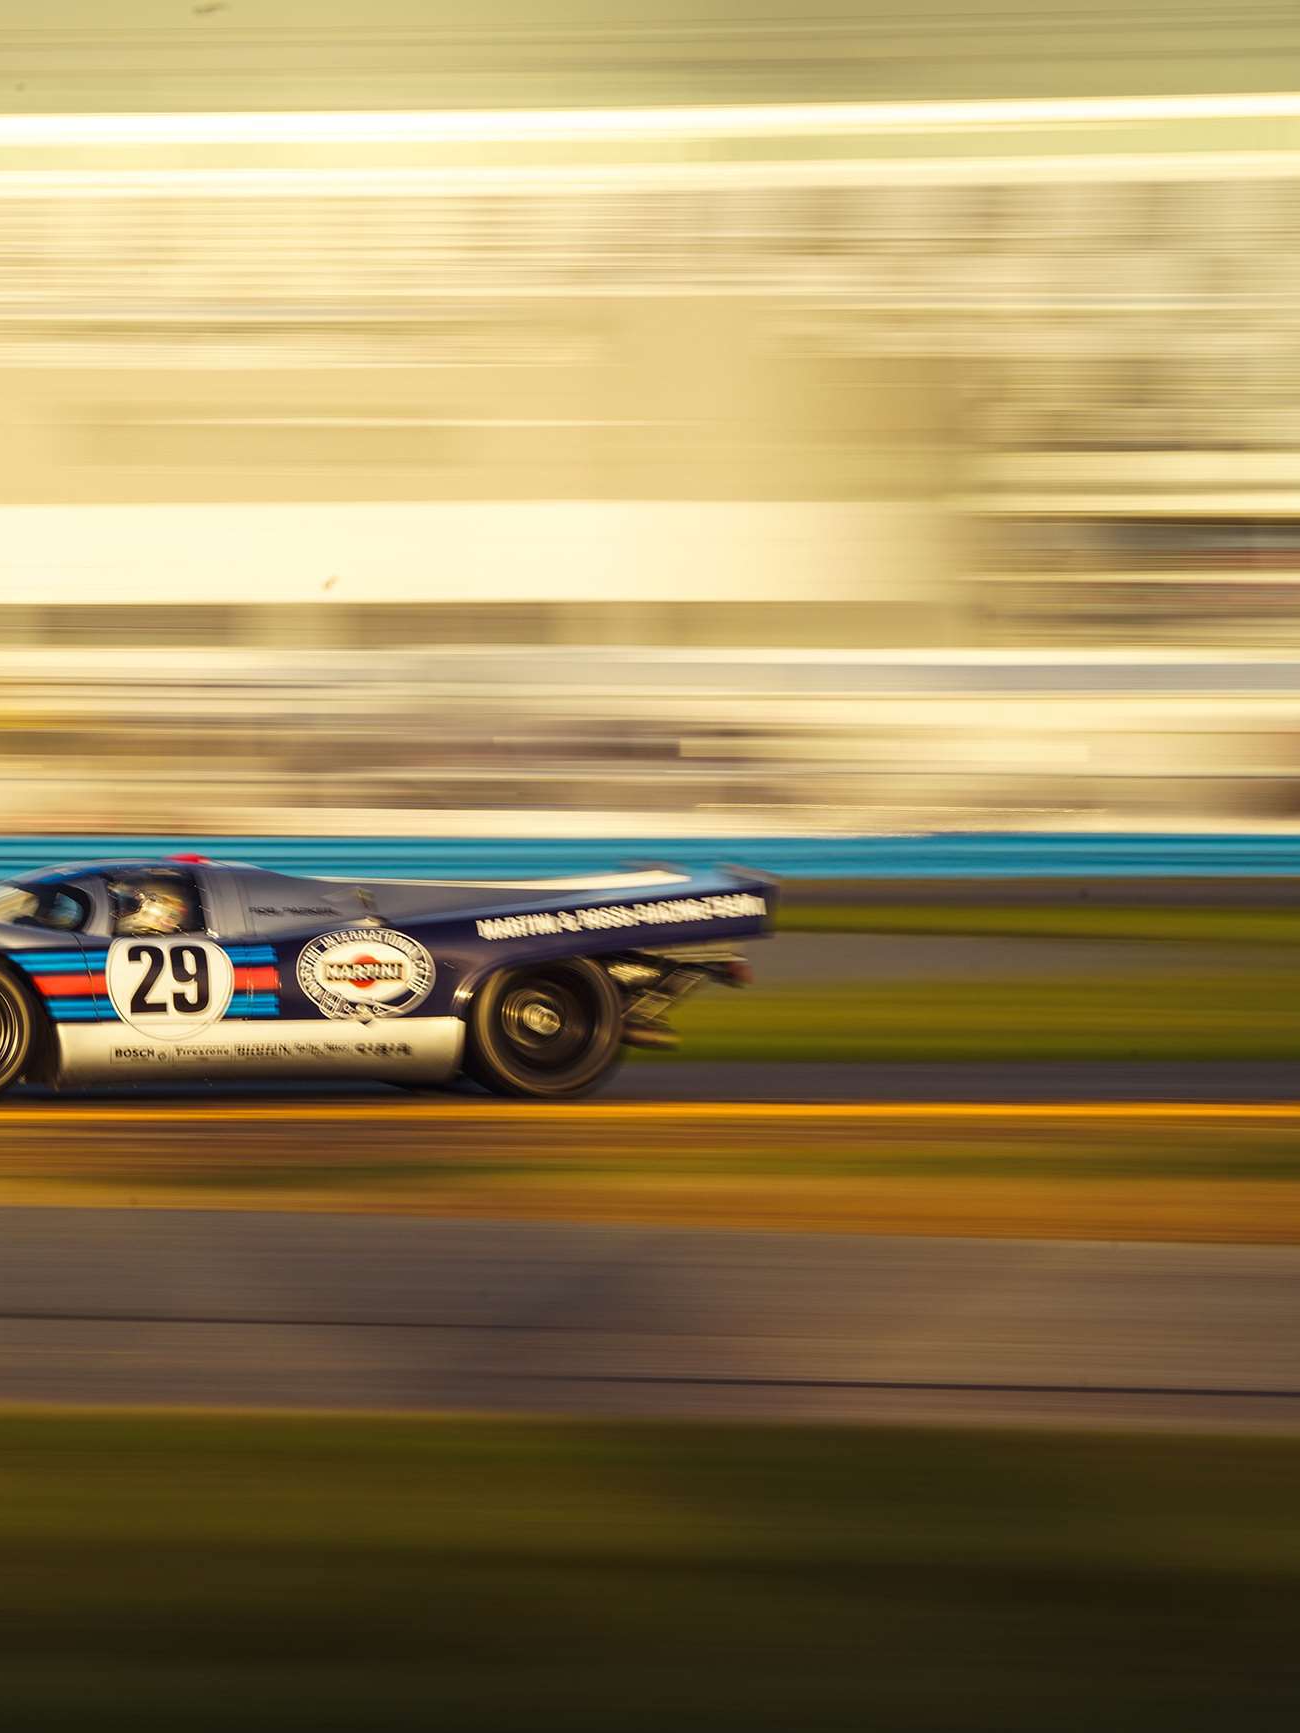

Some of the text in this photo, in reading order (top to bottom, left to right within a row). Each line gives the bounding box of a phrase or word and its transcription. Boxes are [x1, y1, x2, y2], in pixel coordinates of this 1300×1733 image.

[476, 912, 563, 940] MARTINI
[557, 911, 581, 932] &
[576, 904, 640, 930] ROSSI
[128, 945, 209, 1013] 29
[325, 962, 403, 981] MARTINI
[114, 1047, 156, 1058] BOSCH
[175, 1047, 230, 1057] Firestone
